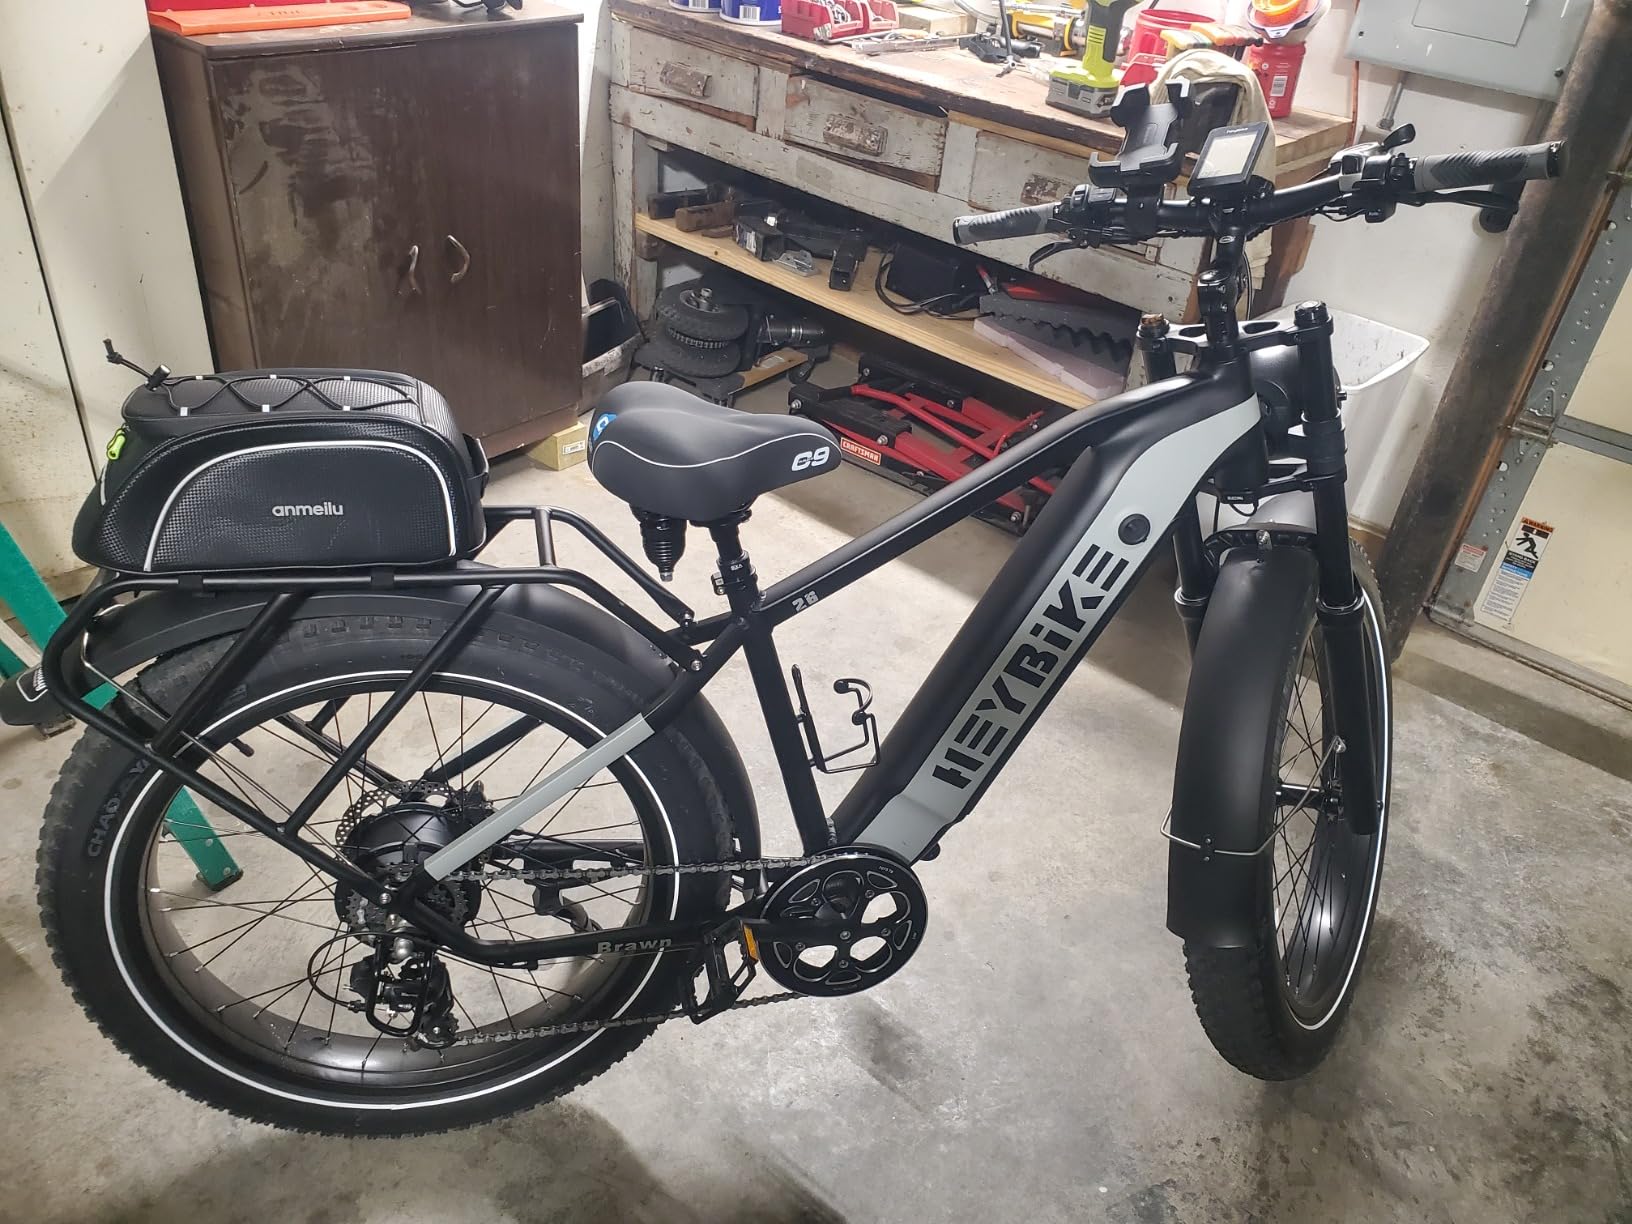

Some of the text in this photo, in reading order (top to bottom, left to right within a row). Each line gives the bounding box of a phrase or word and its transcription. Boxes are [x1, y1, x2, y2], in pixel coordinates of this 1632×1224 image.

[842, 441, 879, 462] CRAFTSMAN
[272, 501, 344, 517] anmeilu
[597, 938, 673, 954] Brawn
